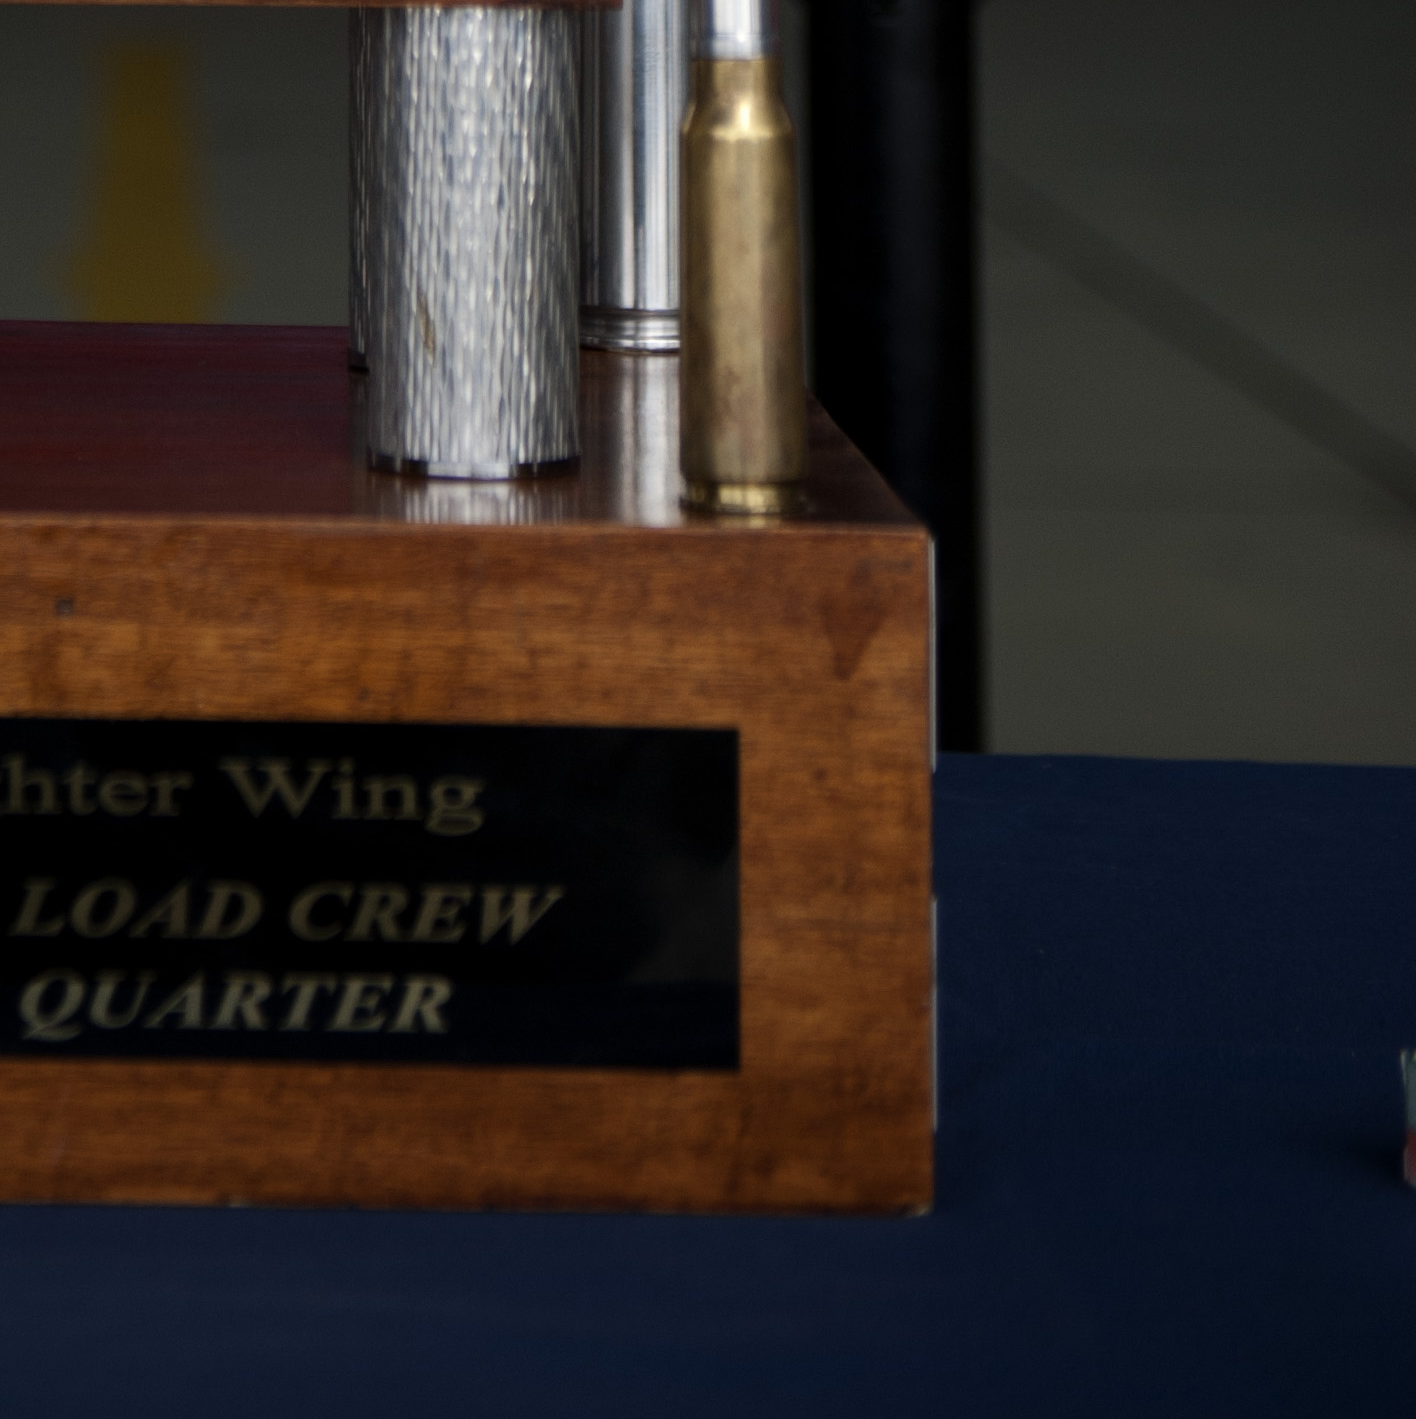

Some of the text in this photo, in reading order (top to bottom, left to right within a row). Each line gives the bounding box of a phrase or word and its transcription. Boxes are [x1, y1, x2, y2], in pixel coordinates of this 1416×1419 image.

[222, 760, 483, 835] Wing
[11, 881, 261, 936] LOAD
[288, 885, 562, 942] CREW
[19, 973, 452, 1040] QUARTER
